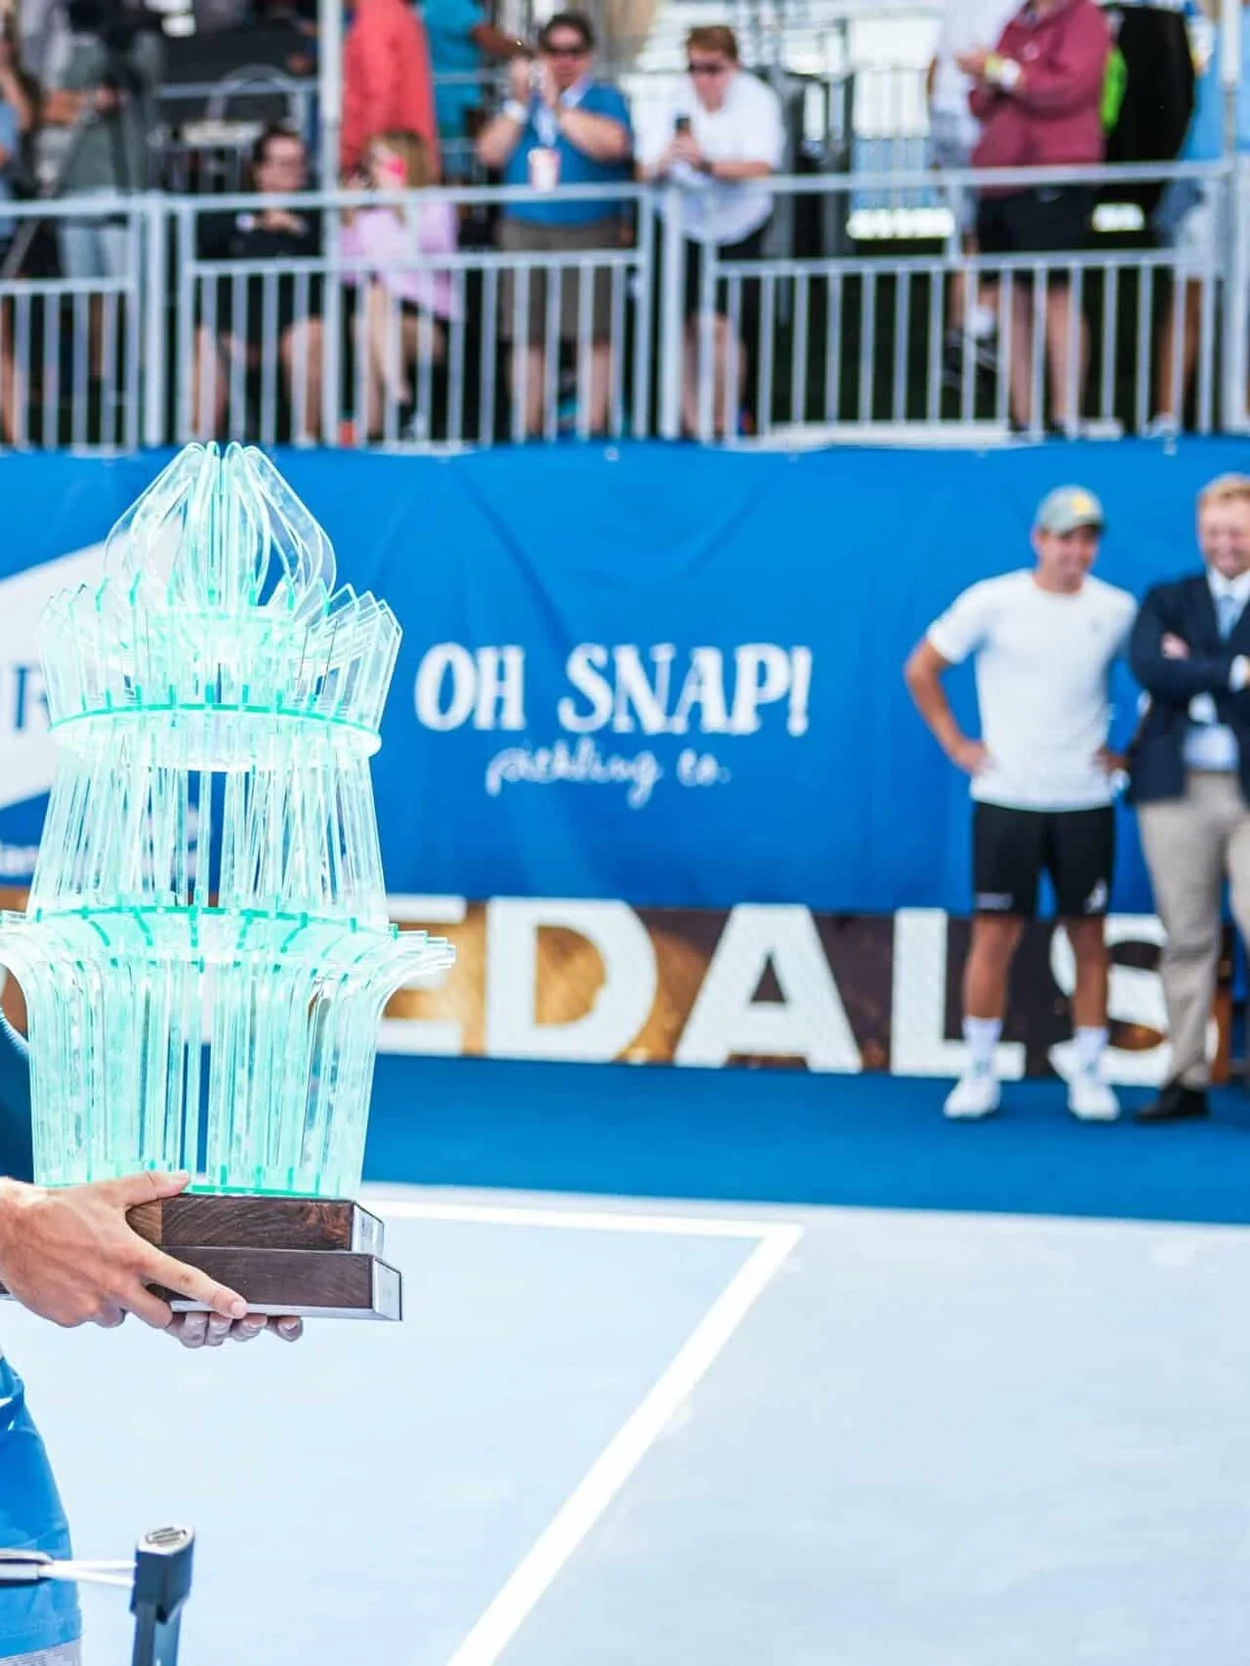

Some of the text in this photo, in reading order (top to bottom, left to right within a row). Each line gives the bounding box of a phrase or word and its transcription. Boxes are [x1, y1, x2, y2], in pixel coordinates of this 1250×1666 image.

[414, 642, 812, 737] OH SNAP!
[377, 893, 1219, 1087] EDALS
